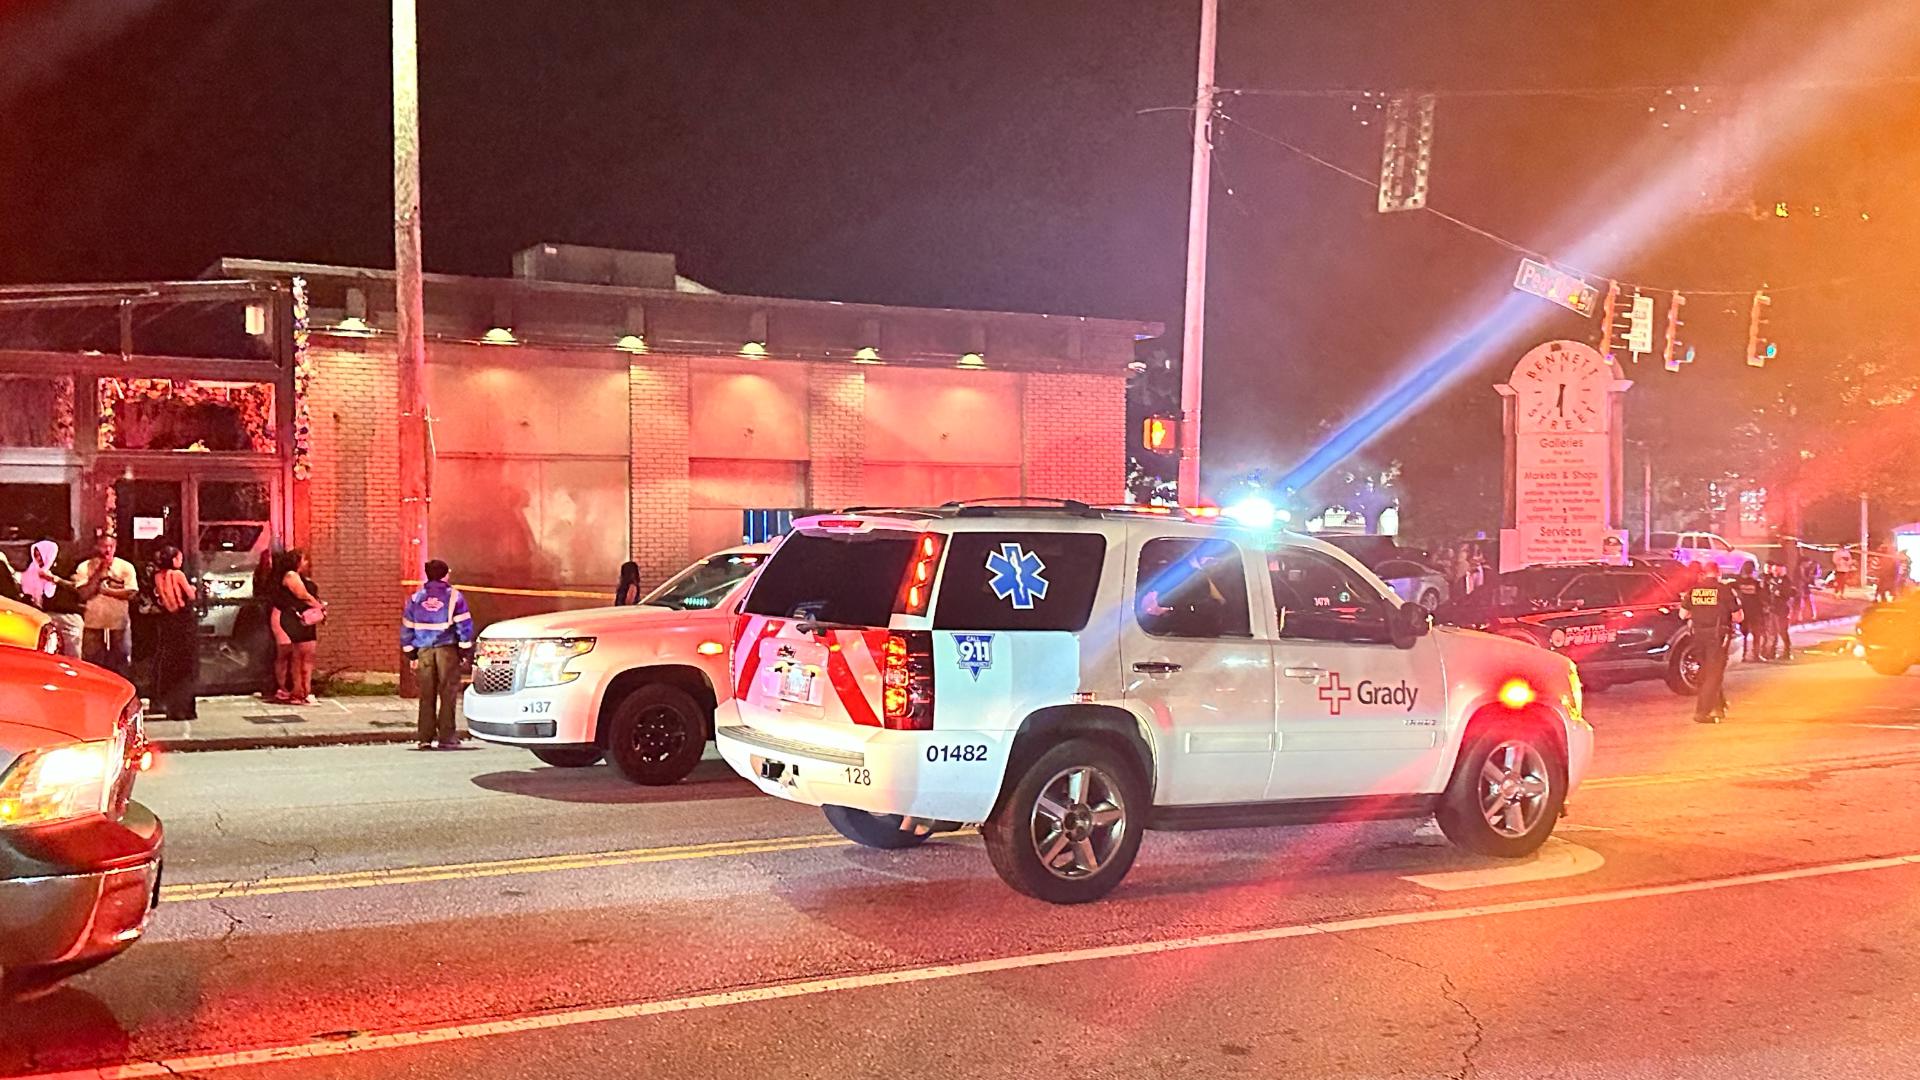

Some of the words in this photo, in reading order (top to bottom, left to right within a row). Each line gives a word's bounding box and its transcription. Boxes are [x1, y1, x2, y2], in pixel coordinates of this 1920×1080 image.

[1526, 352, 1599, 379] BENNETT
[1528, 407, 1596, 430] STREET
[1539, 438, 1584, 449] Galleries
[1524, 471, 1558, 480] Markets
[1573, 471, 1599, 481] Shops
[1540, 526, 1583, 537] Services
[1692, 597, 1718, 606] POLICE
[1564, 629, 1617, 647] POLICE
[1357, 679, 1419, 712] Grady
[529, 701, 552, 714] 137
[926, 744, 988, 762] 01482
[845, 767, 872, 786] 128
